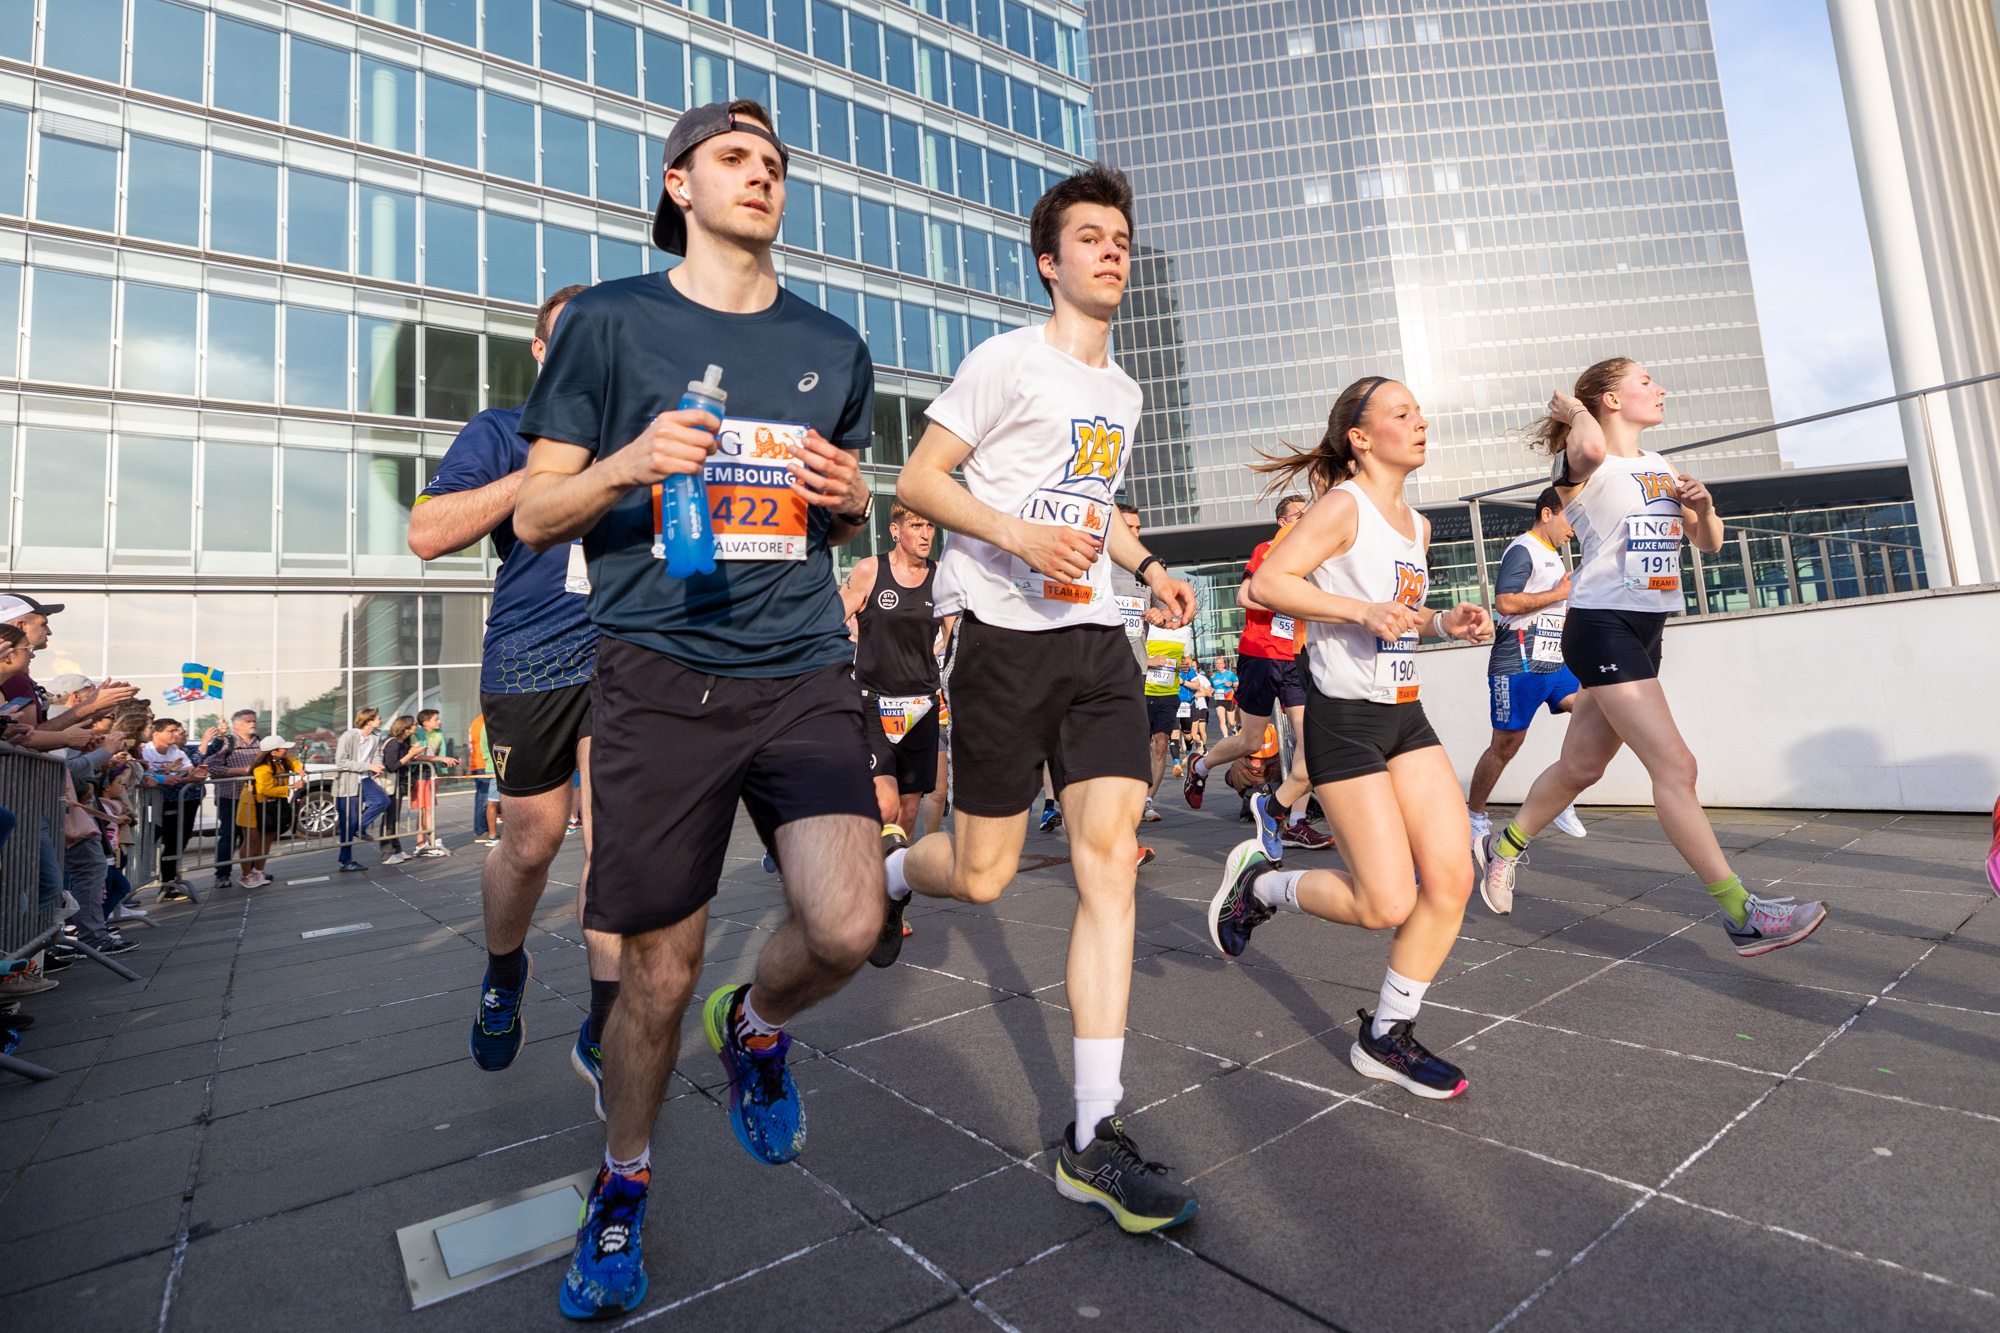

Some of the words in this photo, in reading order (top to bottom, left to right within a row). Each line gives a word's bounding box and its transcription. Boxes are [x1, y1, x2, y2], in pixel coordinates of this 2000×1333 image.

[703, 467, 797, 485] EMBOURG
[1029, 499, 1080, 524] ING
[1432, 523, 1520, 536] UXEMOURG
[1634, 522, 1668, 536] ING
[715, 541, 783, 553] ALVATORE
[1048, 585, 1073, 598] TEAM
[1074, 589, 1090, 599] RUN
[1540, 618, 1560, 629] ING
[1153, 671, 1170, 679] 8877
